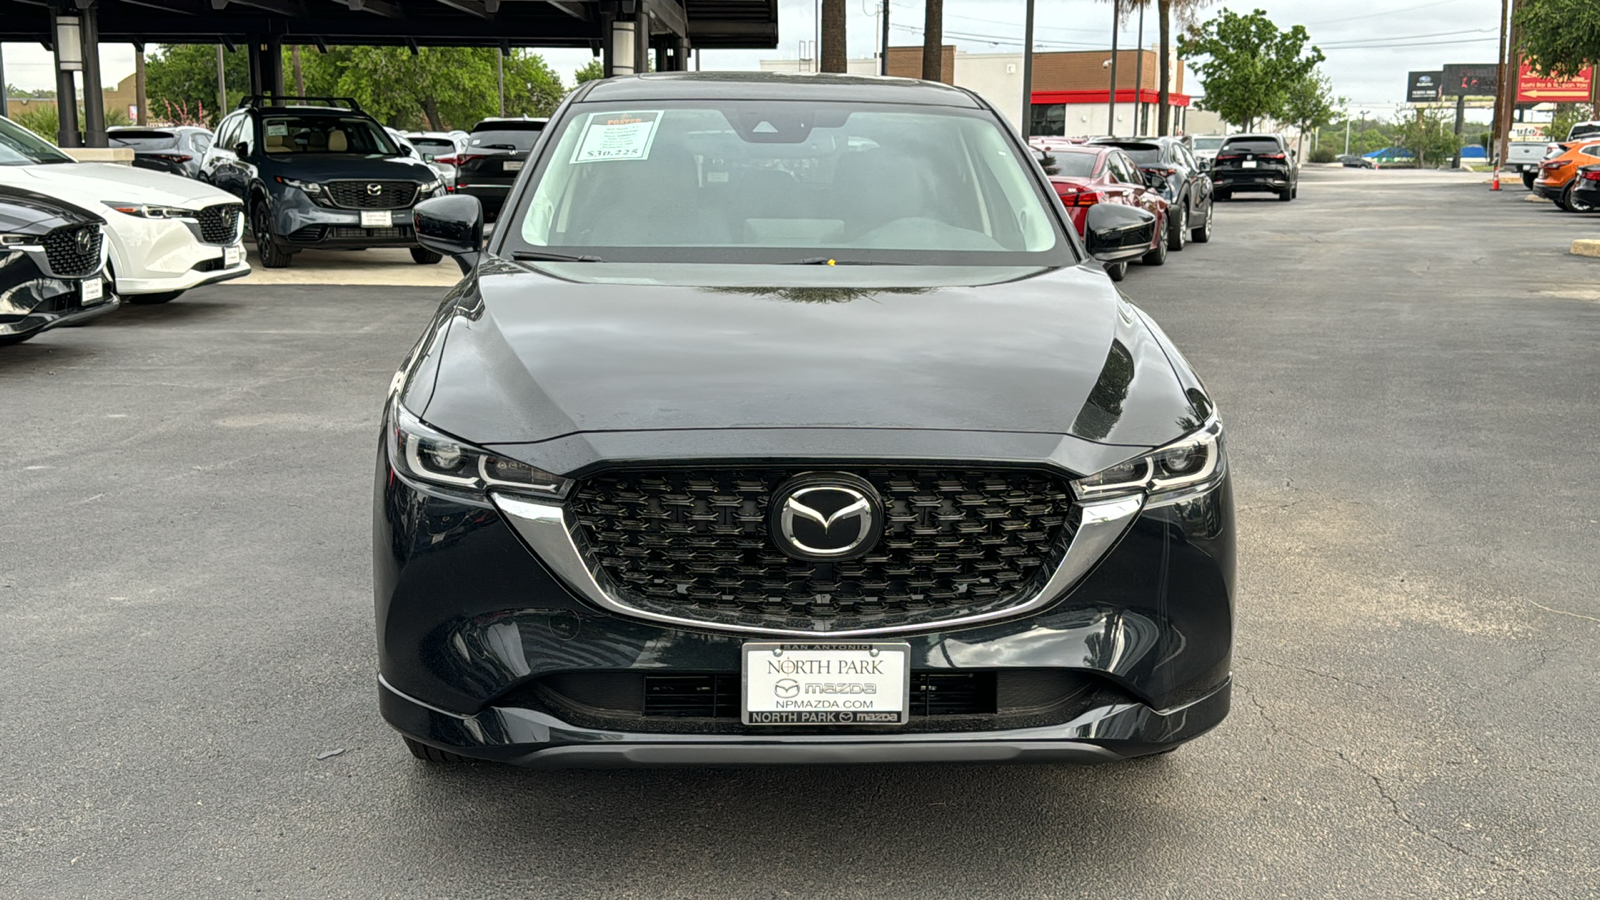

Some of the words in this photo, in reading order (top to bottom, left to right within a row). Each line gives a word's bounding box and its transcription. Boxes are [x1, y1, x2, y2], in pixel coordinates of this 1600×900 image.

[767, 659, 830, 675] NORTH
[838, 659, 884, 675] PARK
[805, 682, 877, 695] mazda
[775, 700, 873, 709] NPMAZDA.COM
[752, 712, 797, 722] NORTH
[801, 712, 836, 722] PARK
[857, 713, 897, 722] mazda
